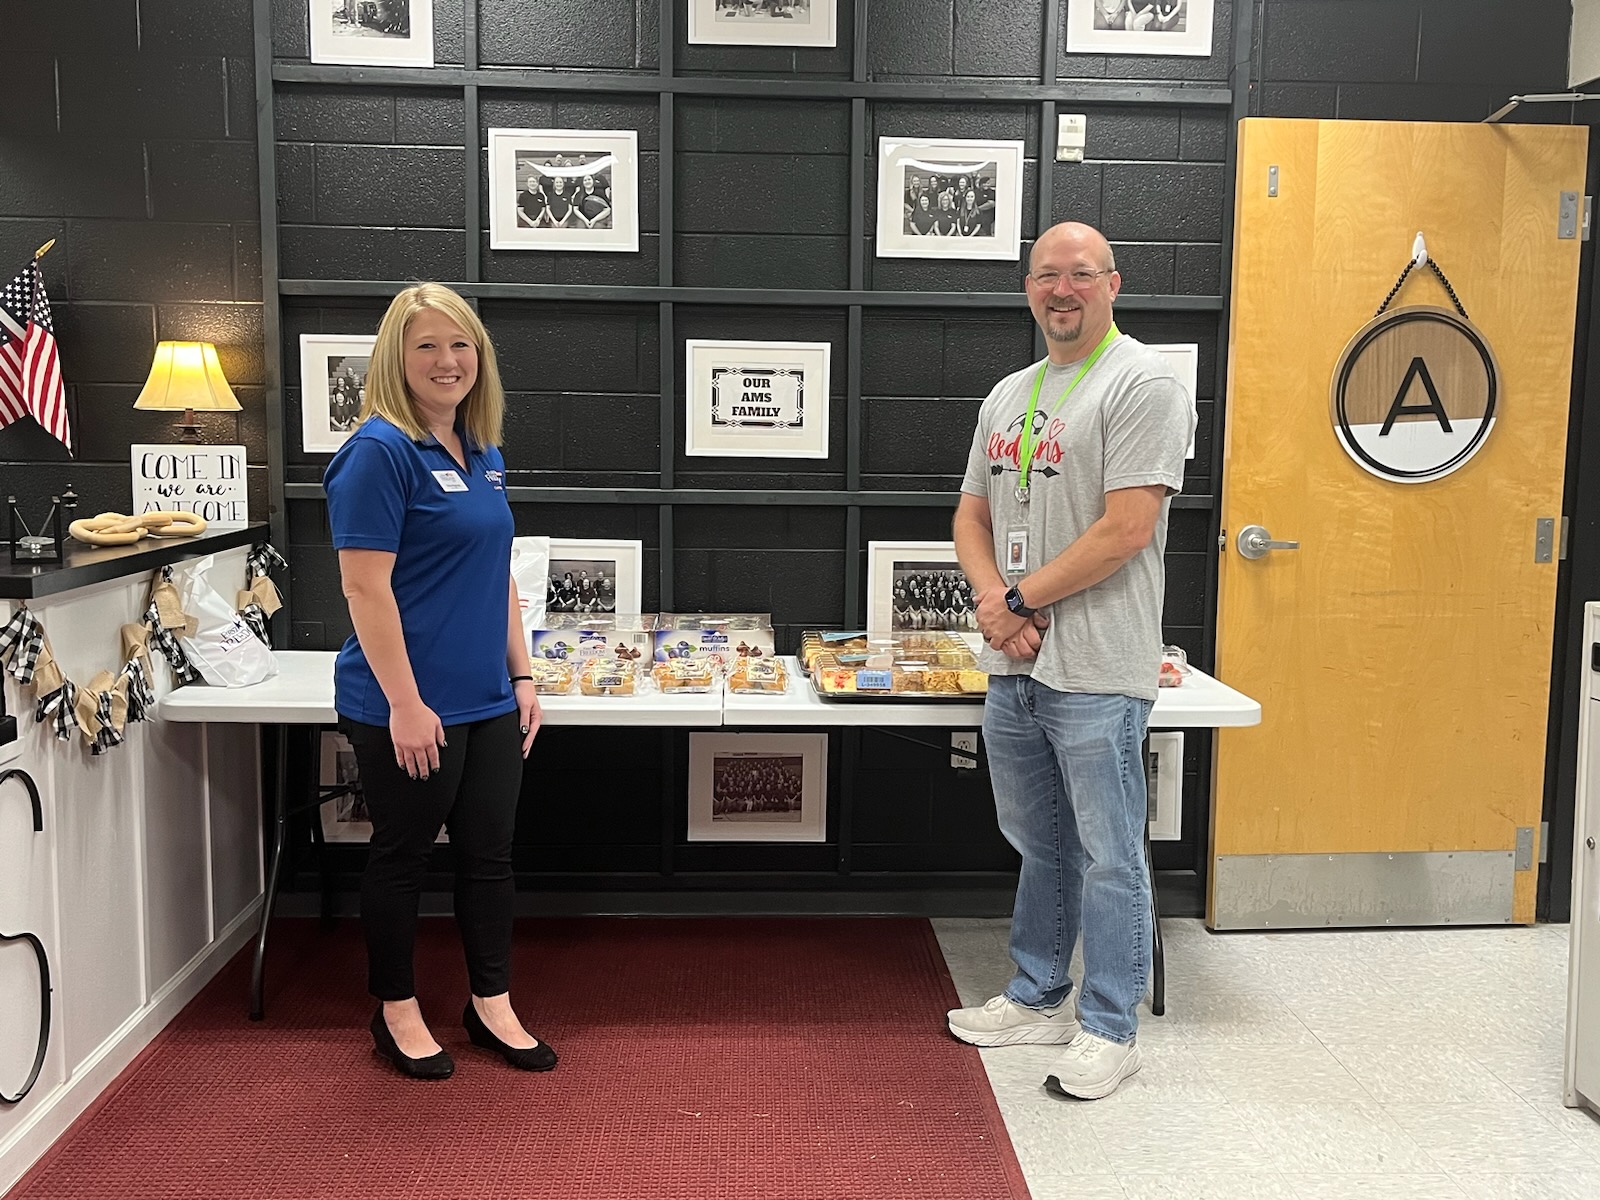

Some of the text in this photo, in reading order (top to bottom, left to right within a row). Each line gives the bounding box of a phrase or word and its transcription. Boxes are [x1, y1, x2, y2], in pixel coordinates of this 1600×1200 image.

[742, 377, 771, 388] OUR
[741, 392, 772, 403] AMS
[1379, 357, 1453, 437] A
[731, 406, 781, 417] FAMILY
[141, 453, 241, 480] COME IN
[157, 483, 227, 498] we are
[699, 644, 730, 652] muffins
